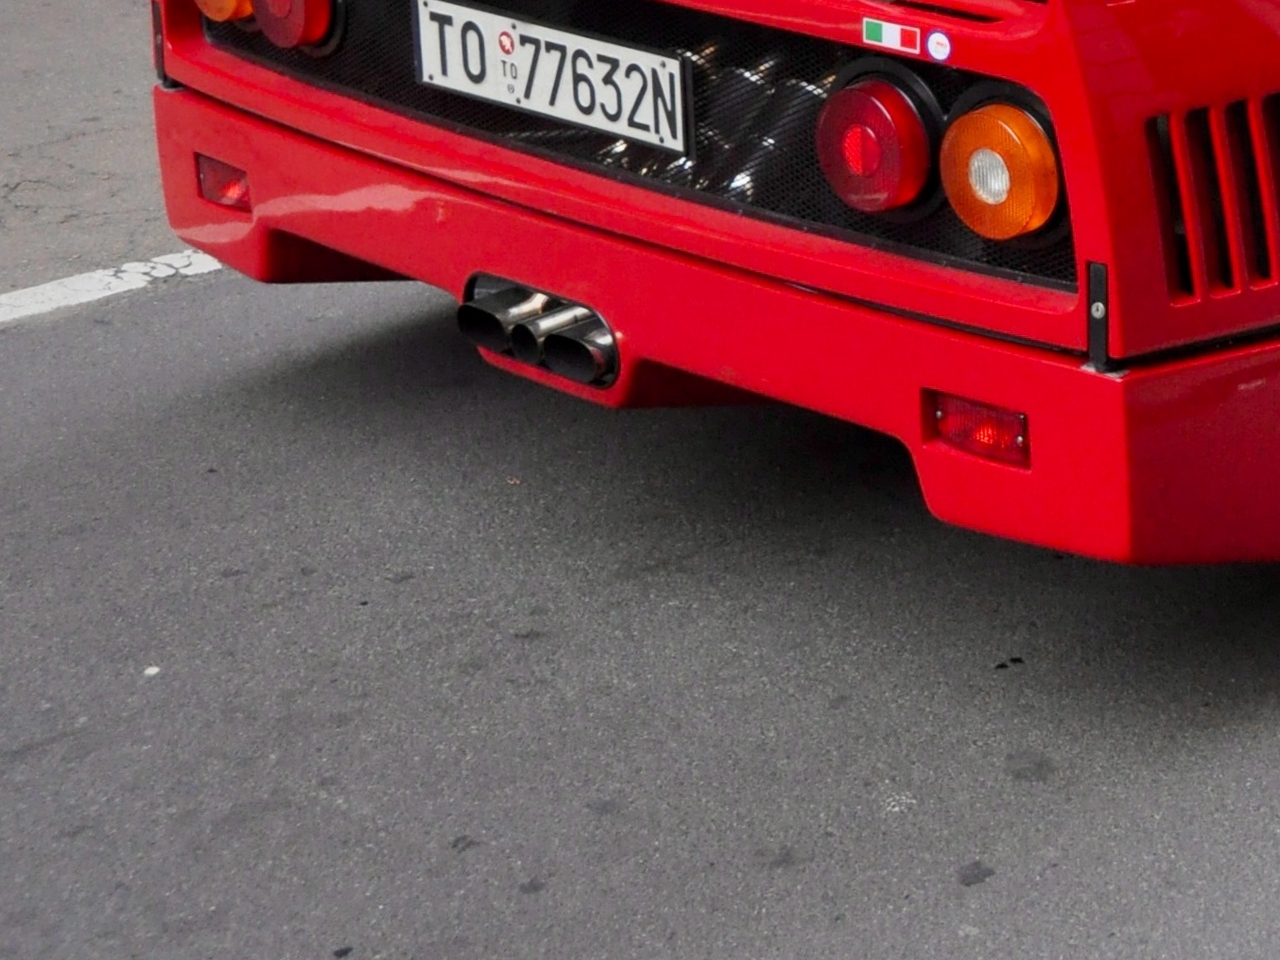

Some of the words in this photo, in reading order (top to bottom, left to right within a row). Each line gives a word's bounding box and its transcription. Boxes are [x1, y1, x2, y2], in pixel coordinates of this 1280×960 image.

[429, 11, 487, 84] TO
[519, 34, 678, 140] 77632N
[501, 59, 518, 80] TO
